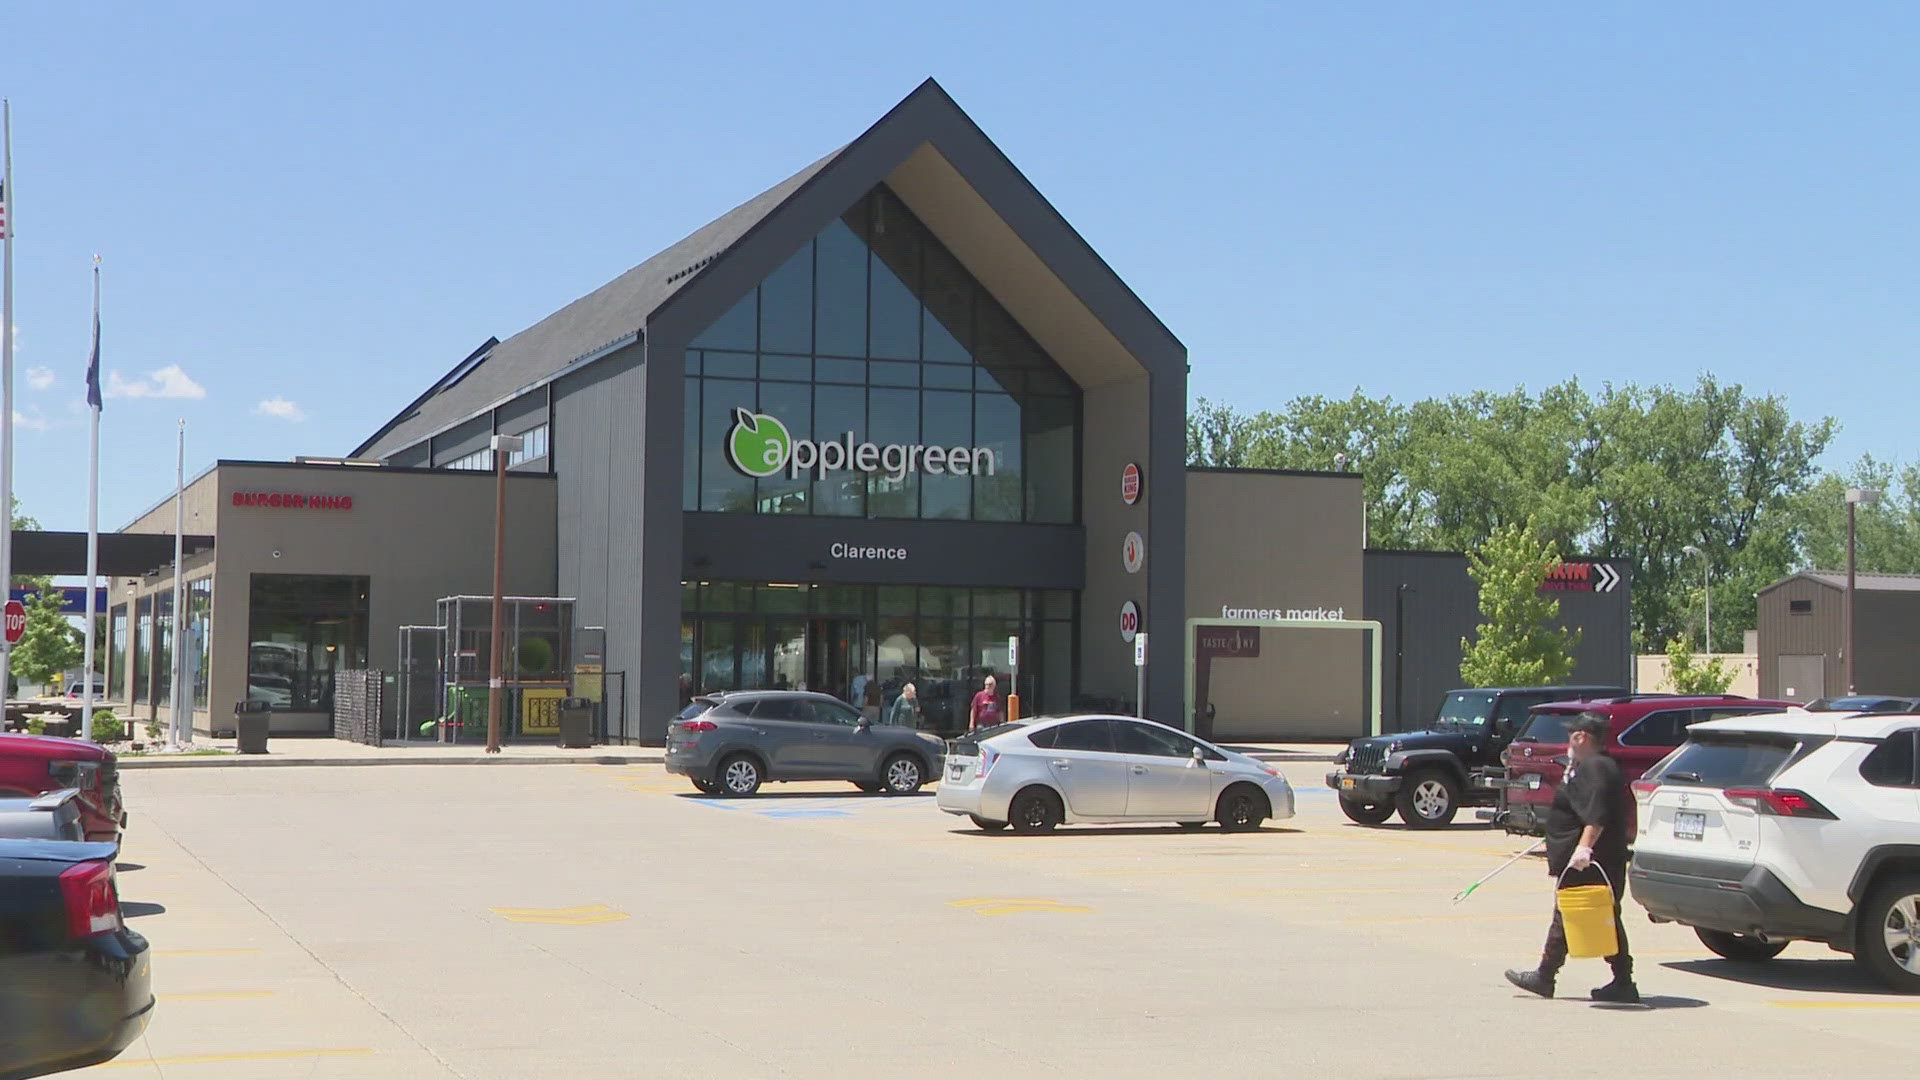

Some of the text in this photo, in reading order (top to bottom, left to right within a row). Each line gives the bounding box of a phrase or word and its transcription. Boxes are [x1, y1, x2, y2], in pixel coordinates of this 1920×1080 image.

[762, 431, 995, 483] applegreen
[232, 491, 353, 511] BURGER KING
[830, 543, 908, 560] Clarence
[6, 614, 25, 630] TOP
[1122, 612, 1136, 631] DD
[1222, 605, 1345, 622] farmers market
[1202, 637, 1255, 649] TASTE NY
